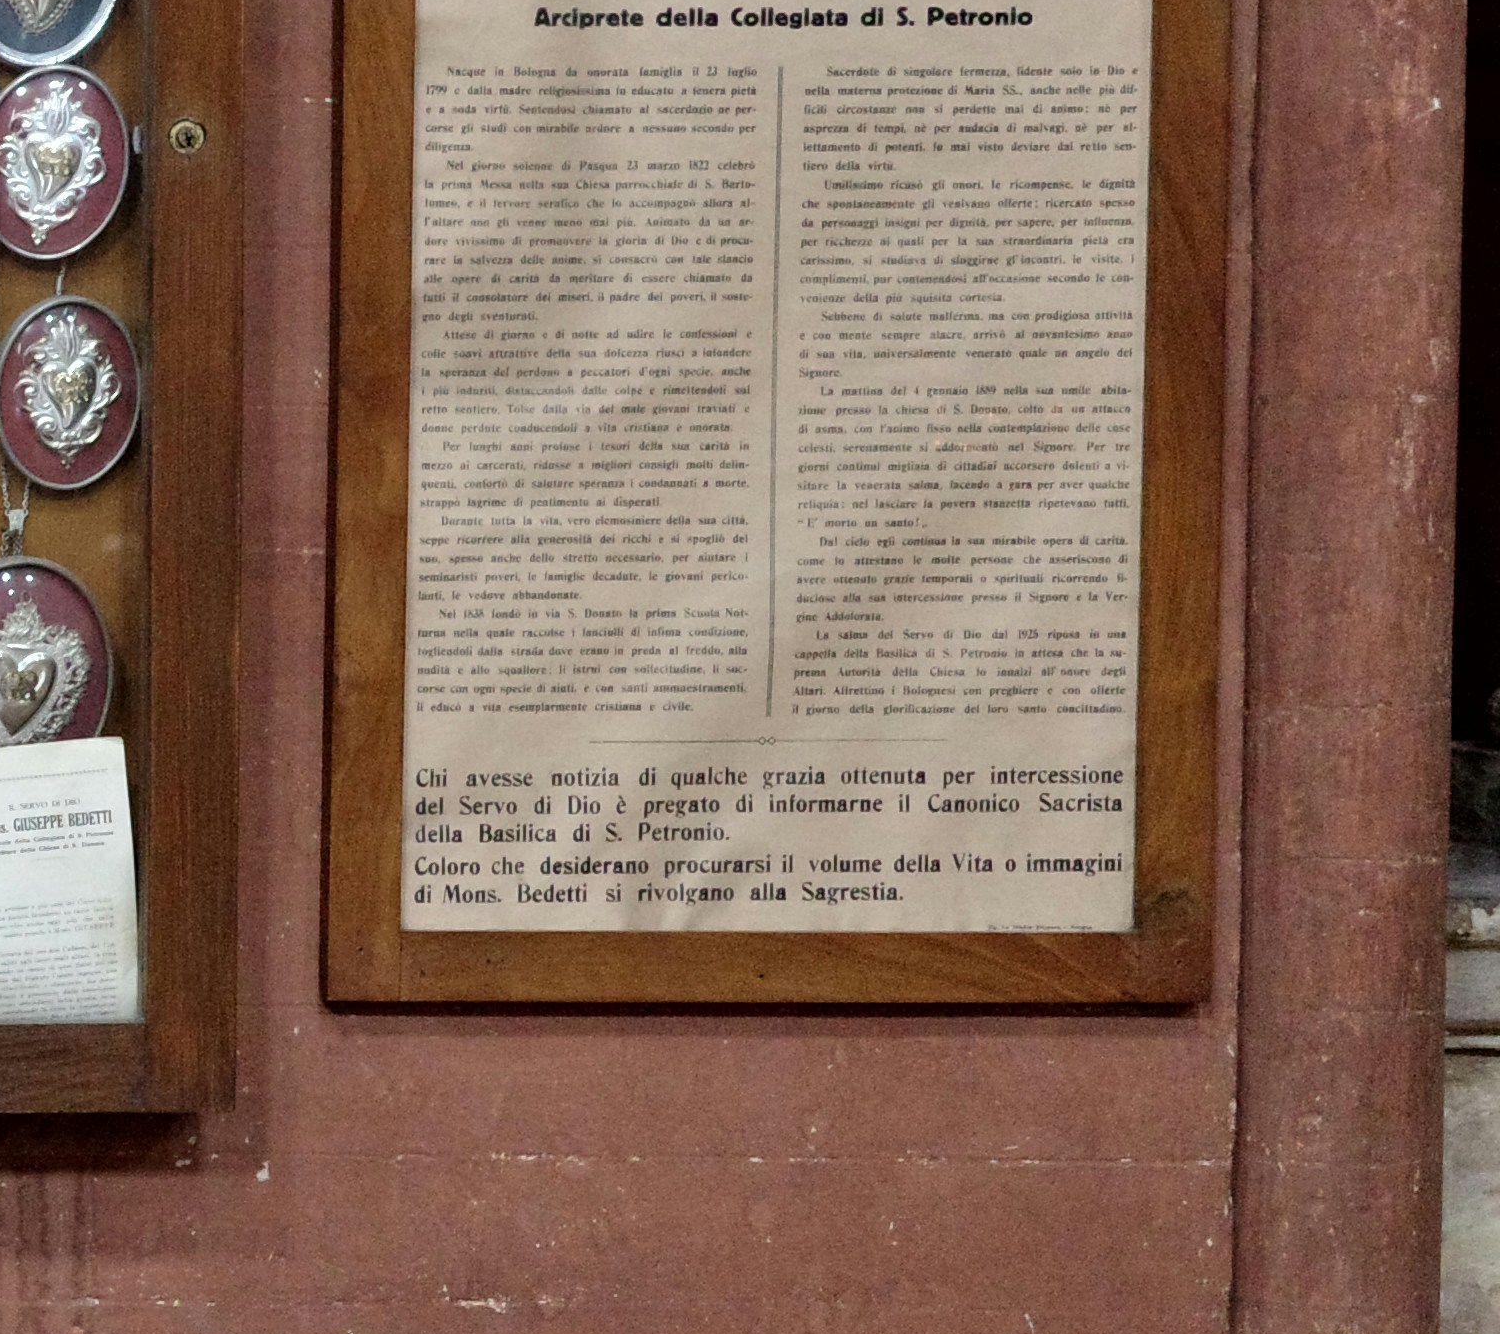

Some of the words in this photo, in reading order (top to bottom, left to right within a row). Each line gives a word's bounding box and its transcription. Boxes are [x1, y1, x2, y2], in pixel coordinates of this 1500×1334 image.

[533, 6, 644, 30] Arciprete
[654, 6, 719, 27] della
[729, 6, 849, 30] Collegiata
[859, 5, 884, 27] di
[895, 5, 915, 27] S.
[926, 5, 1033, 27] Petronio
[415, 767, 448, 788] Chi
[464, 772, 534, 788] avesse
[550, 766, 620, 787] notizia
[637, 766, 657, 787] di
[669, 765, 748, 791] qualche
[761, 764, 826, 790] grazia
[839, 767, 927, 785] ottenuta
[942, 769, 976, 790] per
[989, 764, 1125, 784] intercessione
[414, 795, 445, 816] del
[458, 794, 518, 816] Servo
[533, 794, 552, 815] di
[567, 794, 601, 815] Dio
[615, 794, 627, 815] è
[642, 795, 721, 817] pregato
[734, 792, 754, 813] di
[768, 792, 884, 814] informarne
[898, 792, 911, 813] il
[926, 791, 1021, 814] Canonico
[1038, 791, 1124, 813] Sacrista
[13, 814, 63, 832] GIUSEPPE
[68, 809, 112, 827] BEDETTI
[414, 823, 463, 844] della
[478, 822, 556, 843] Basilica
[571, 822, 591, 843] di
[604, 821, 623, 843] S.
[637, 820, 730, 842] Petronio.
[413, 855, 481, 876] Coloro
[490, 855, 525, 875] che
[539, 854, 650, 875] desiderano
[663, 853, 771, 879] procurarsi
[781, 853, 794, 874] il
[808, 853, 883, 873] volume
[892, 853, 942, 874] della
[951, 852, 994, 873] Vita
[1004, 857, 1017, 873] o
[1025, 851, 1122, 877] immagini
[413, 883, 432, 904] di
[442, 883, 502, 904] Mons.
[516, 882, 587, 904] Bedetti
[604, 881, 622, 903] si
[636, 881, 735, 906] rivolgano
[748, 881, 787, 902] alla
[800, 880, 904, 906] Sagrestia.
